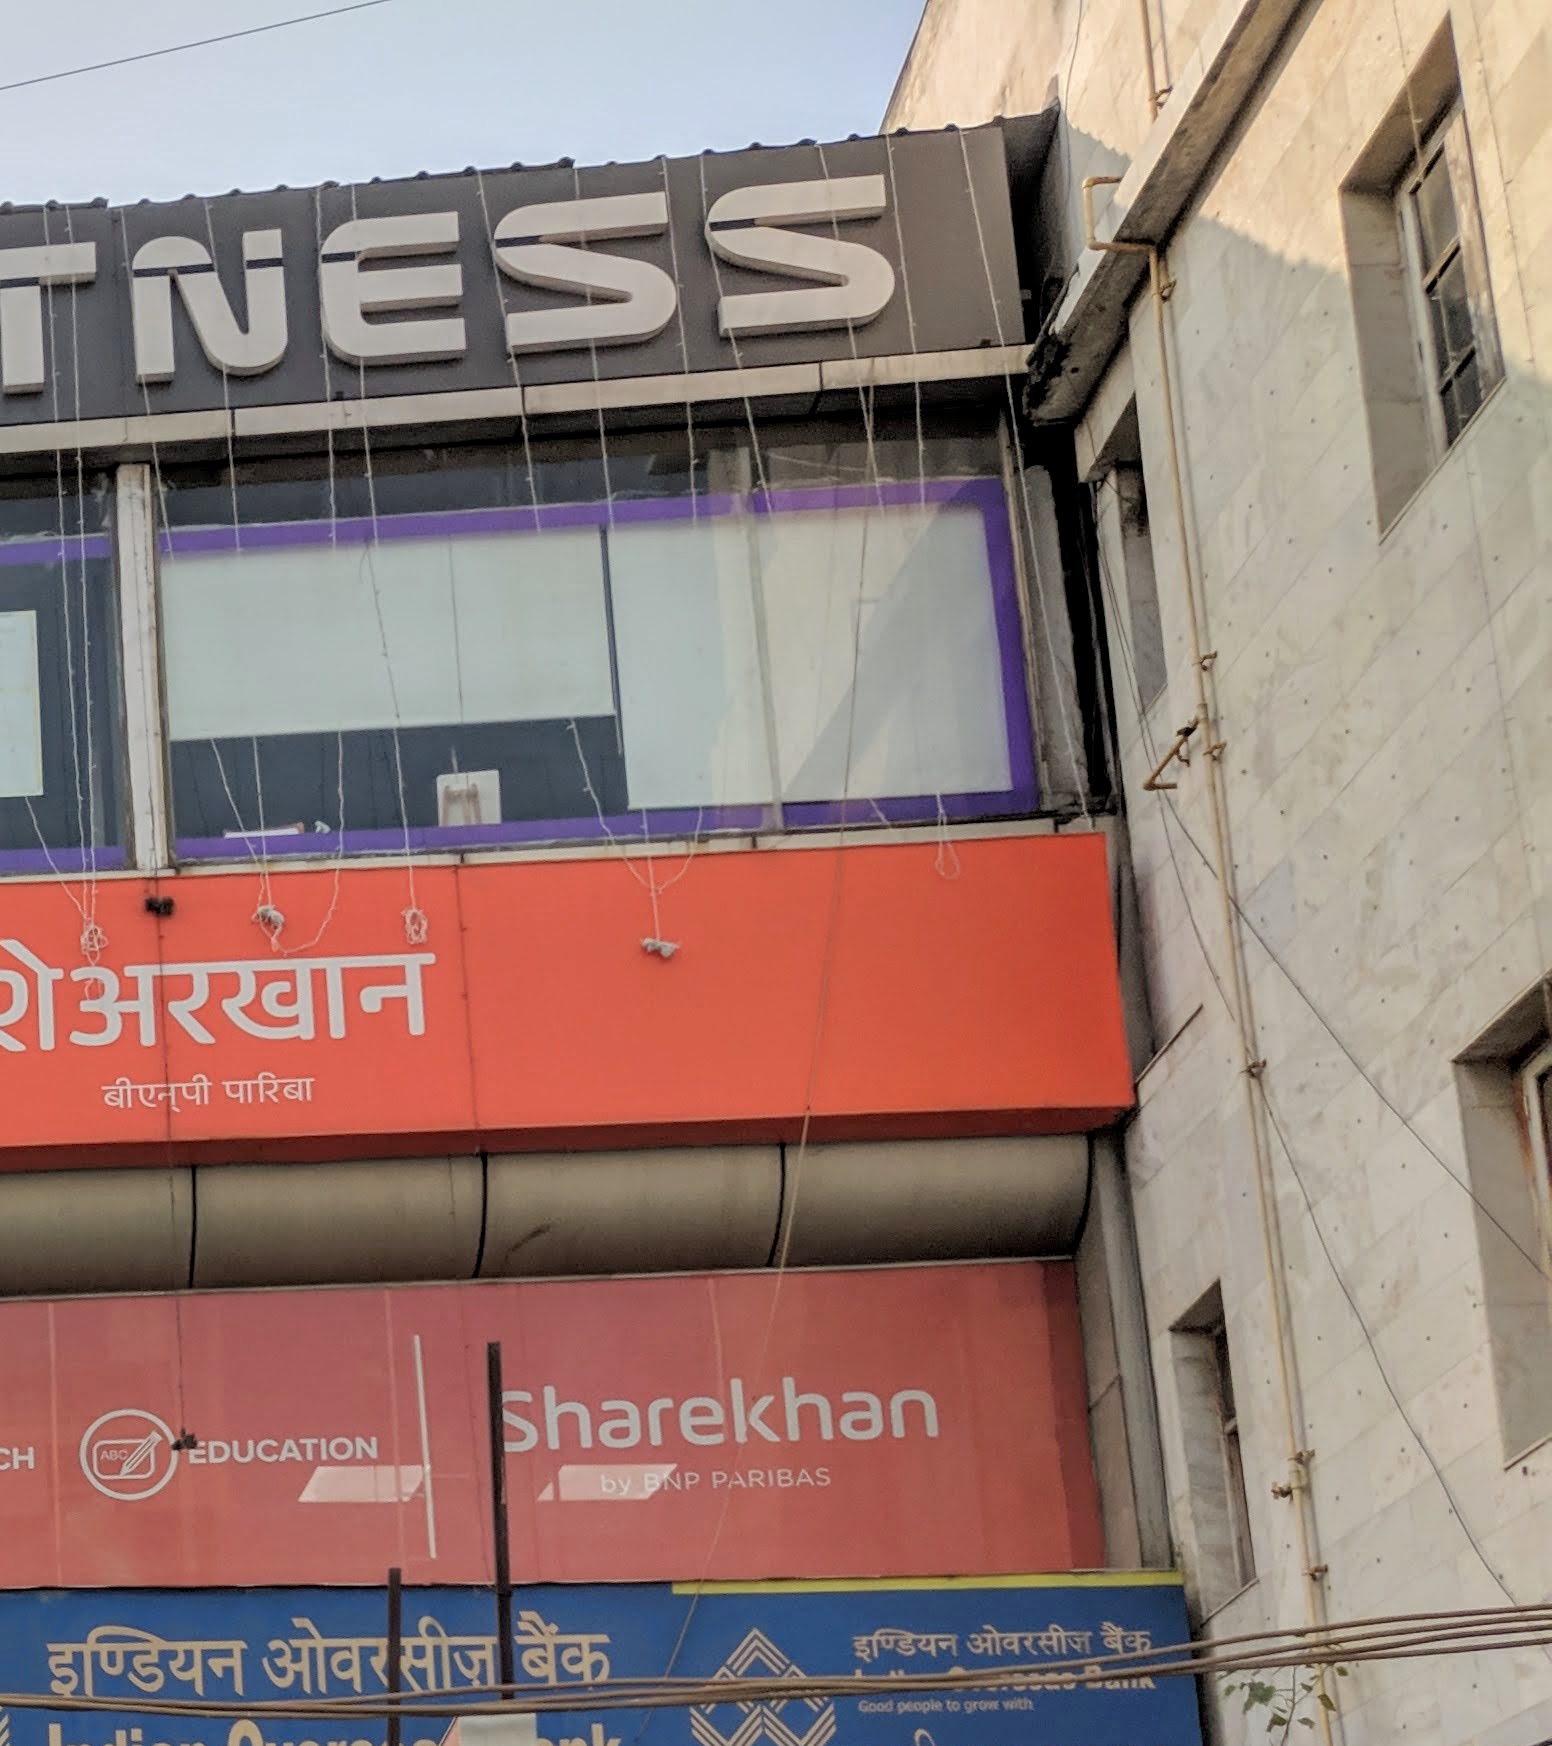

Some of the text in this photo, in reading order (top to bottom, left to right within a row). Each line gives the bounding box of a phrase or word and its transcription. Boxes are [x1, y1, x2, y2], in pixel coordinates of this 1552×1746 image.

[222, 1071, 316, 1104] पारिबा
[500, 1375, 939, 1456] Sharekhan
[188, 1436, 379, 1465] EDUCATION
[599, 1467, 832, 1496] by BNP PARIBAS
[518, 1610, 612, 1689] बैंक
[858, 1700, 894, 1714] Good
[897, 1700, 944, 1717] people
[946, 1700, 961, 1713] to
[1003, 1698, 1034, 1712] with
